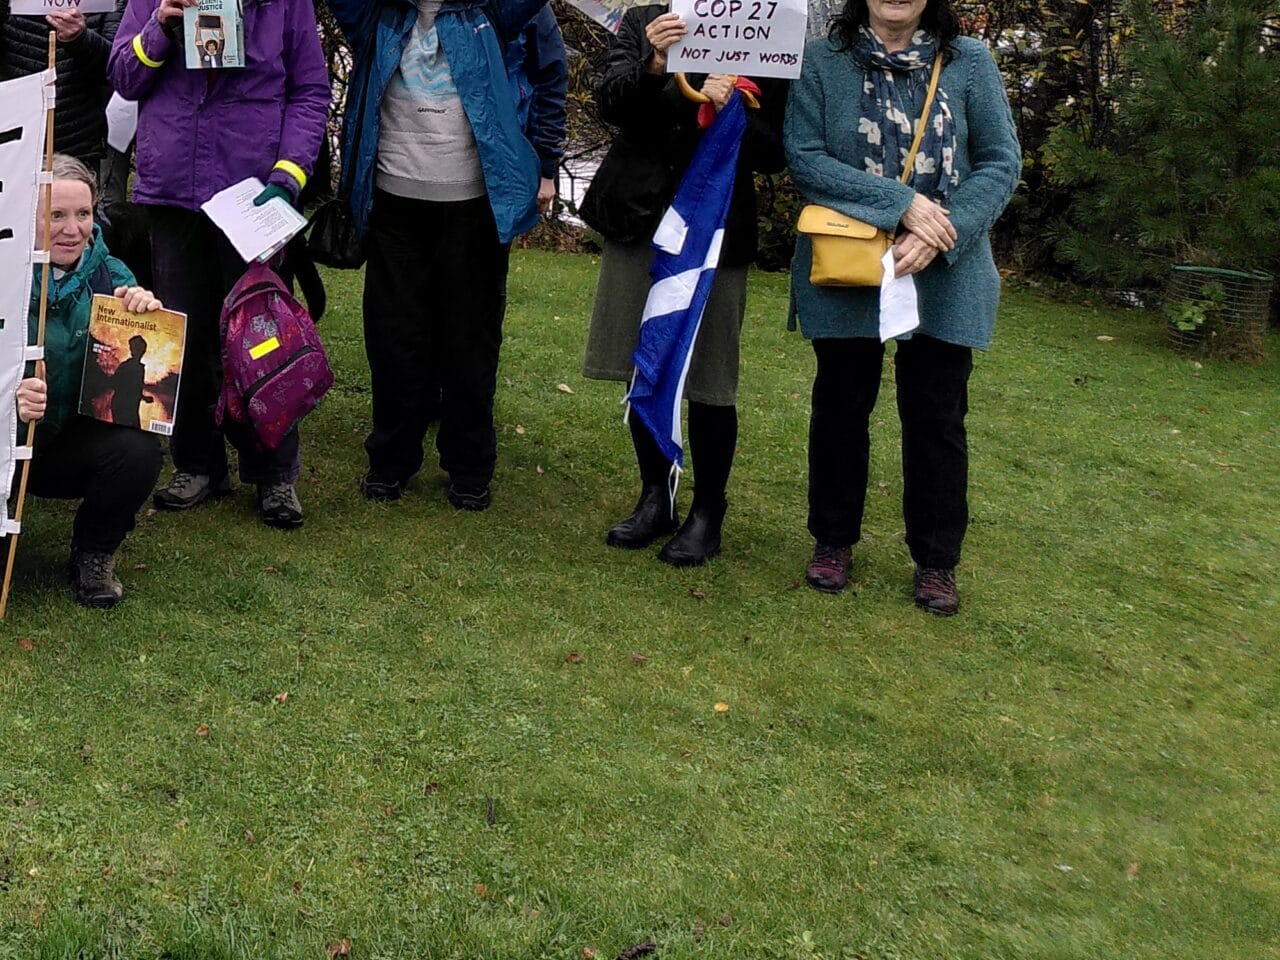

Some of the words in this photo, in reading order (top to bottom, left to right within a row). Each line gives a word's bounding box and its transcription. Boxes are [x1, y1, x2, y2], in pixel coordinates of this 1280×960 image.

[747, 1, 778, 21] 27
[693, 23, 771, 40] ACTION
[680, 46, 711, 61] NOT
[715, 49, 750, 63] JUST
[759, 52, 799, 66] WORDS
[98, 304, 116, 315] New
[96, 312, 157, 332] Internationalist
